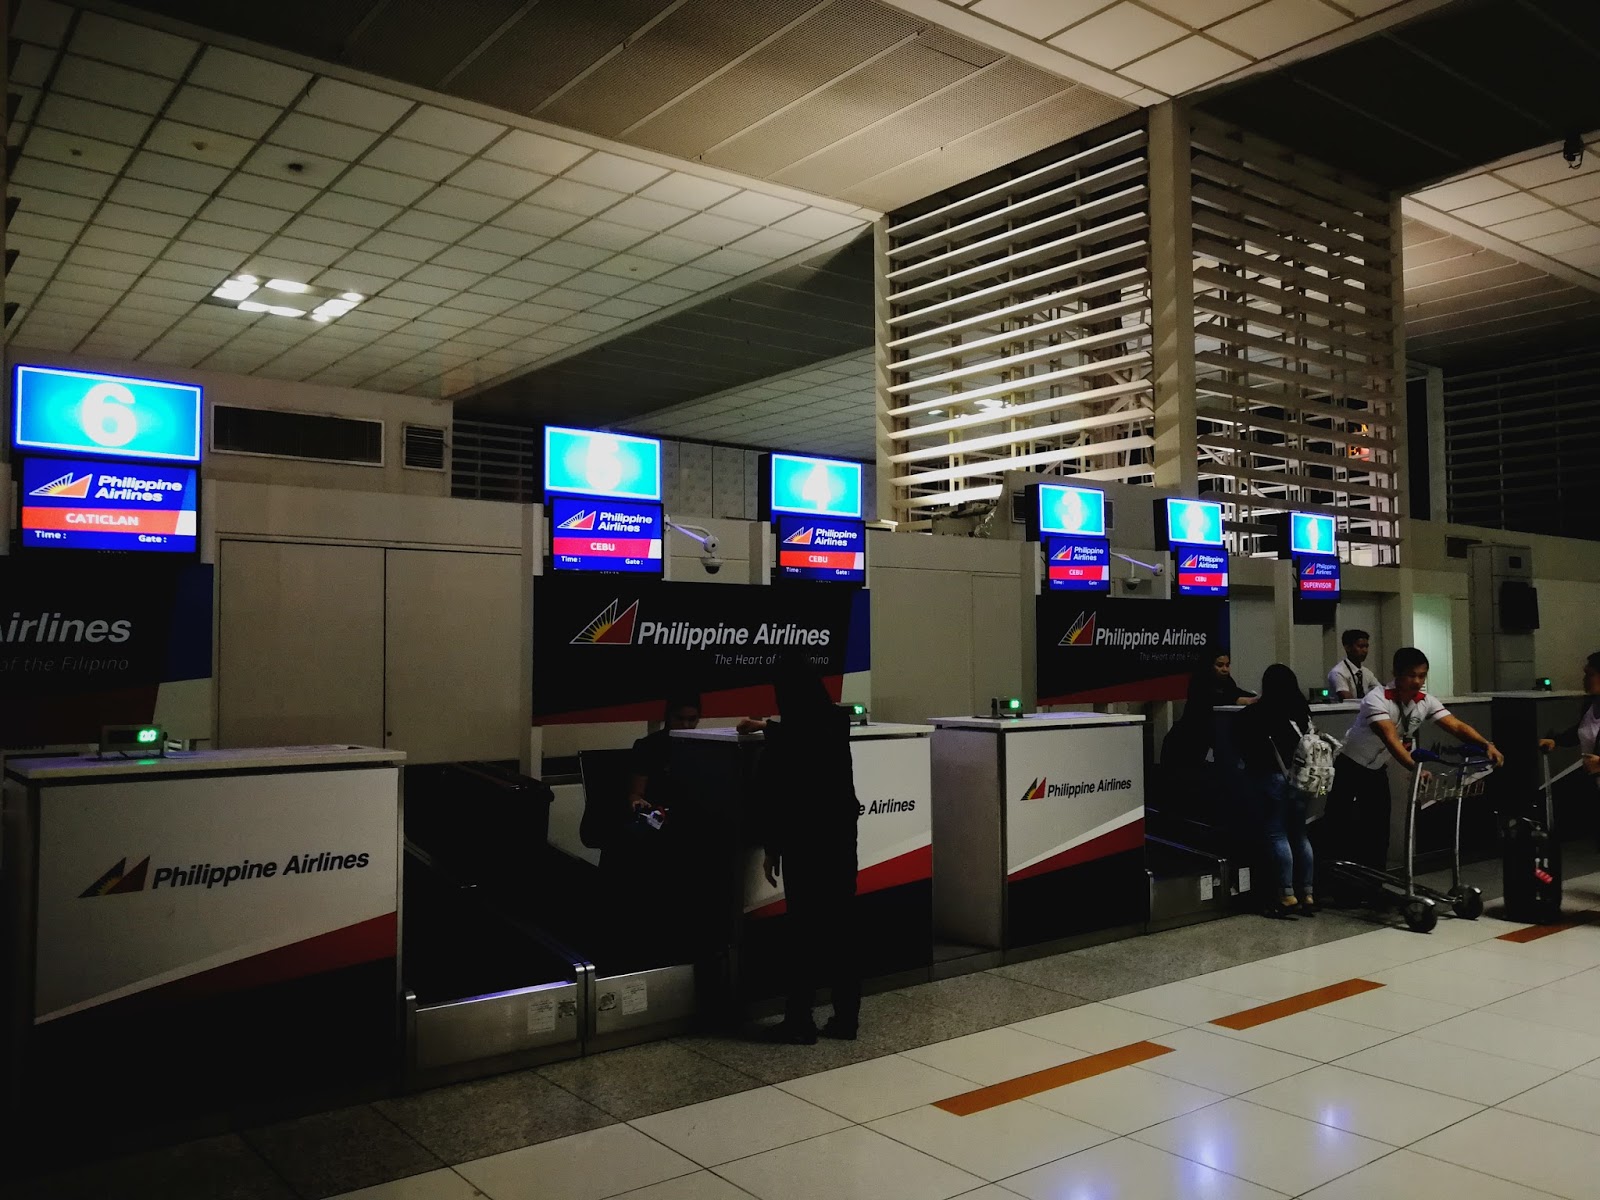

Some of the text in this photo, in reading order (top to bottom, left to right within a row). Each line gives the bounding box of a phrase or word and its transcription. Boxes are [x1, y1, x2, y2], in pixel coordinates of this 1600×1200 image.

[82, 382, 136, 447] 6
[98, 475, 182, 492] Philippine
[803, 464, 831, 511] 4
[95, 486, 163, 502] Airlines
[600, 512, 652, 524] Philippine
[1062, 490, 1083, 531] 3
[66, 513, 139, 527] CATICLAN
[598, 522, 641, 532] Airlines
[816, 528, 857, 539] Philippine
[1308, 518, 1319, 551] 1
[590, 542, 615, 551] CEBU
[815, 537, 847, 546] Airlines
[1073, 553, 1097, 561] Airlines
[1074, 546, 1104, 555] Philippine
[809, 555, 828, 563] CEBU
[1199, 555, 1224, 564] Philippine
[1316, 562, 1336, 570] Philippine
[1069, 568, 1083, 576] CEBU
[0, 612, 132, 643] irlines
[638, 621, 830, 650] Philippine Airlines
[1096, 628, 1207, 650] Philippine Airlines
[24, 657, 55, 672] the
[61, 656, 129, 675] Filipino
[715, 653, 733, 665] The
[735, 653, 763, 665] Heart
[765, 653, 776, 665] of
[1047, 777, 1132, 799] Philippine Airlines
[868, 797, 916, 815] Airlines
[153, 852, 369, 890] Philippine Airlines
